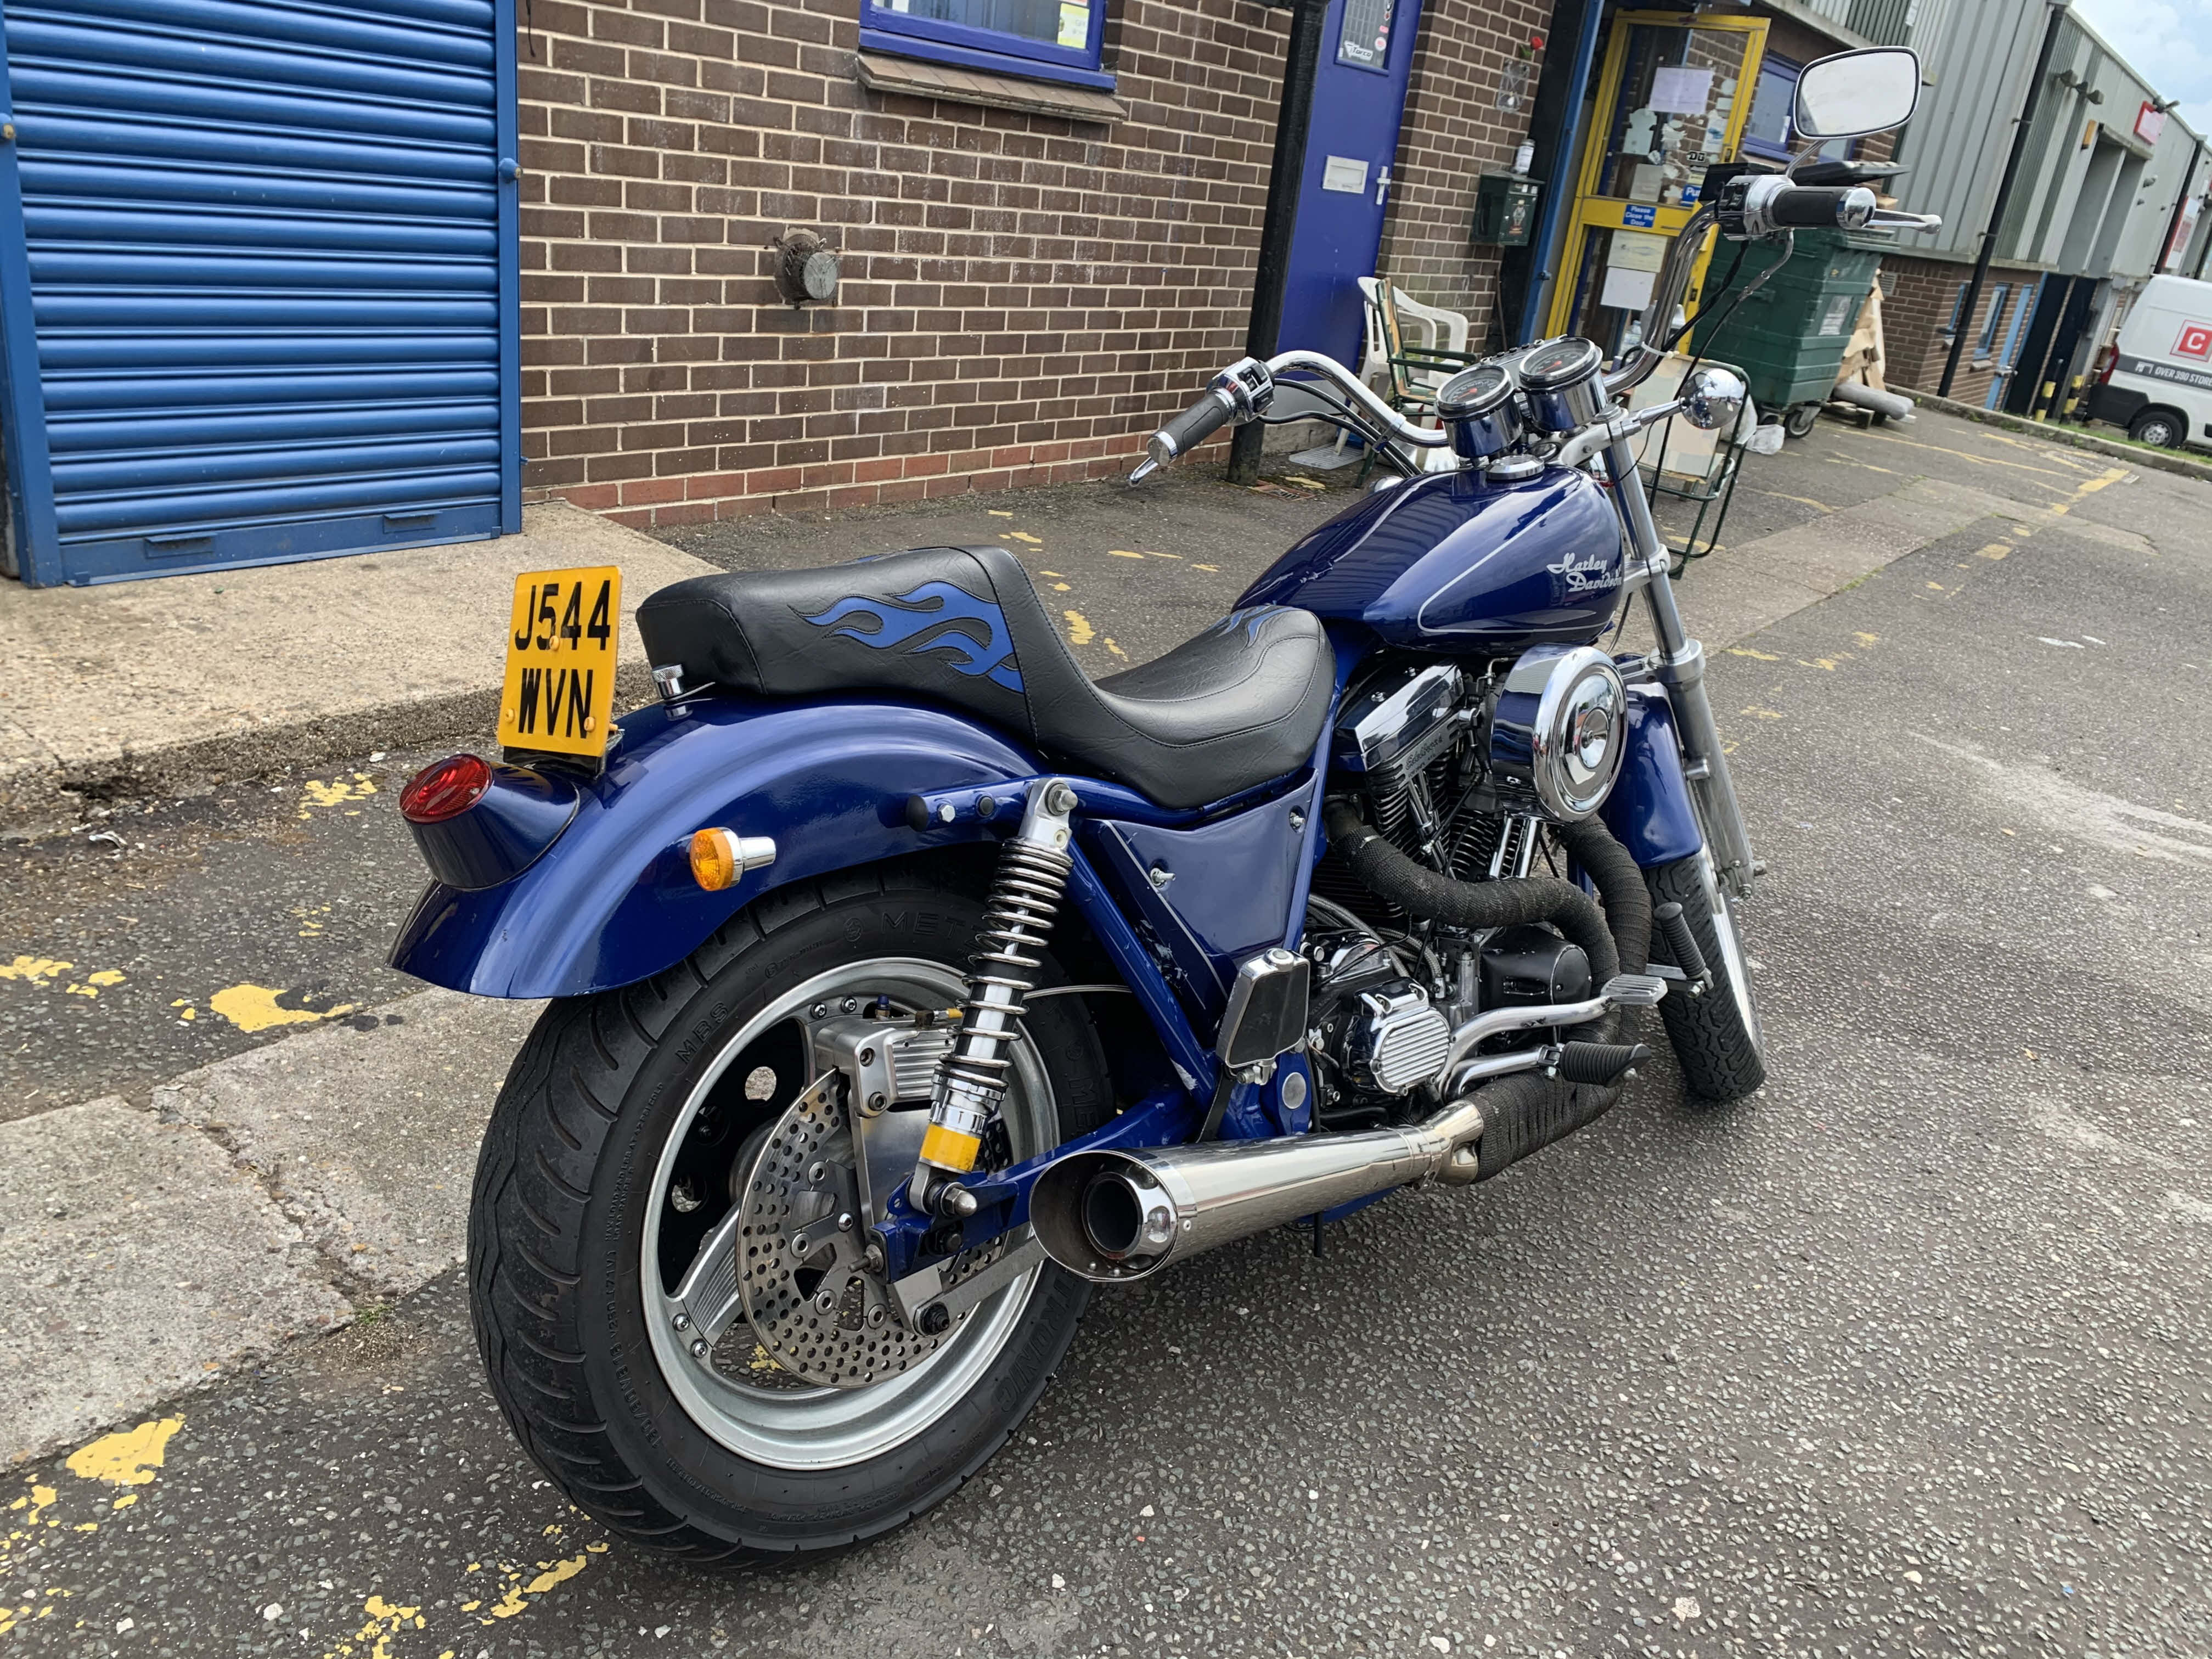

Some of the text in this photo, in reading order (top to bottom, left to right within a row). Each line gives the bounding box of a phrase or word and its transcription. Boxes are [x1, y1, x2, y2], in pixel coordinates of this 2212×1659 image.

[2155, 366, 2175, 378] OVER
[1546, 552, 1607, 574] Harley
[1566, 564, 1622, 592] Davidson
[515, 580, 610, 650] J544
[518, 668, 593, 739] WVN
[676, 1002, 729, 1065] MBS
